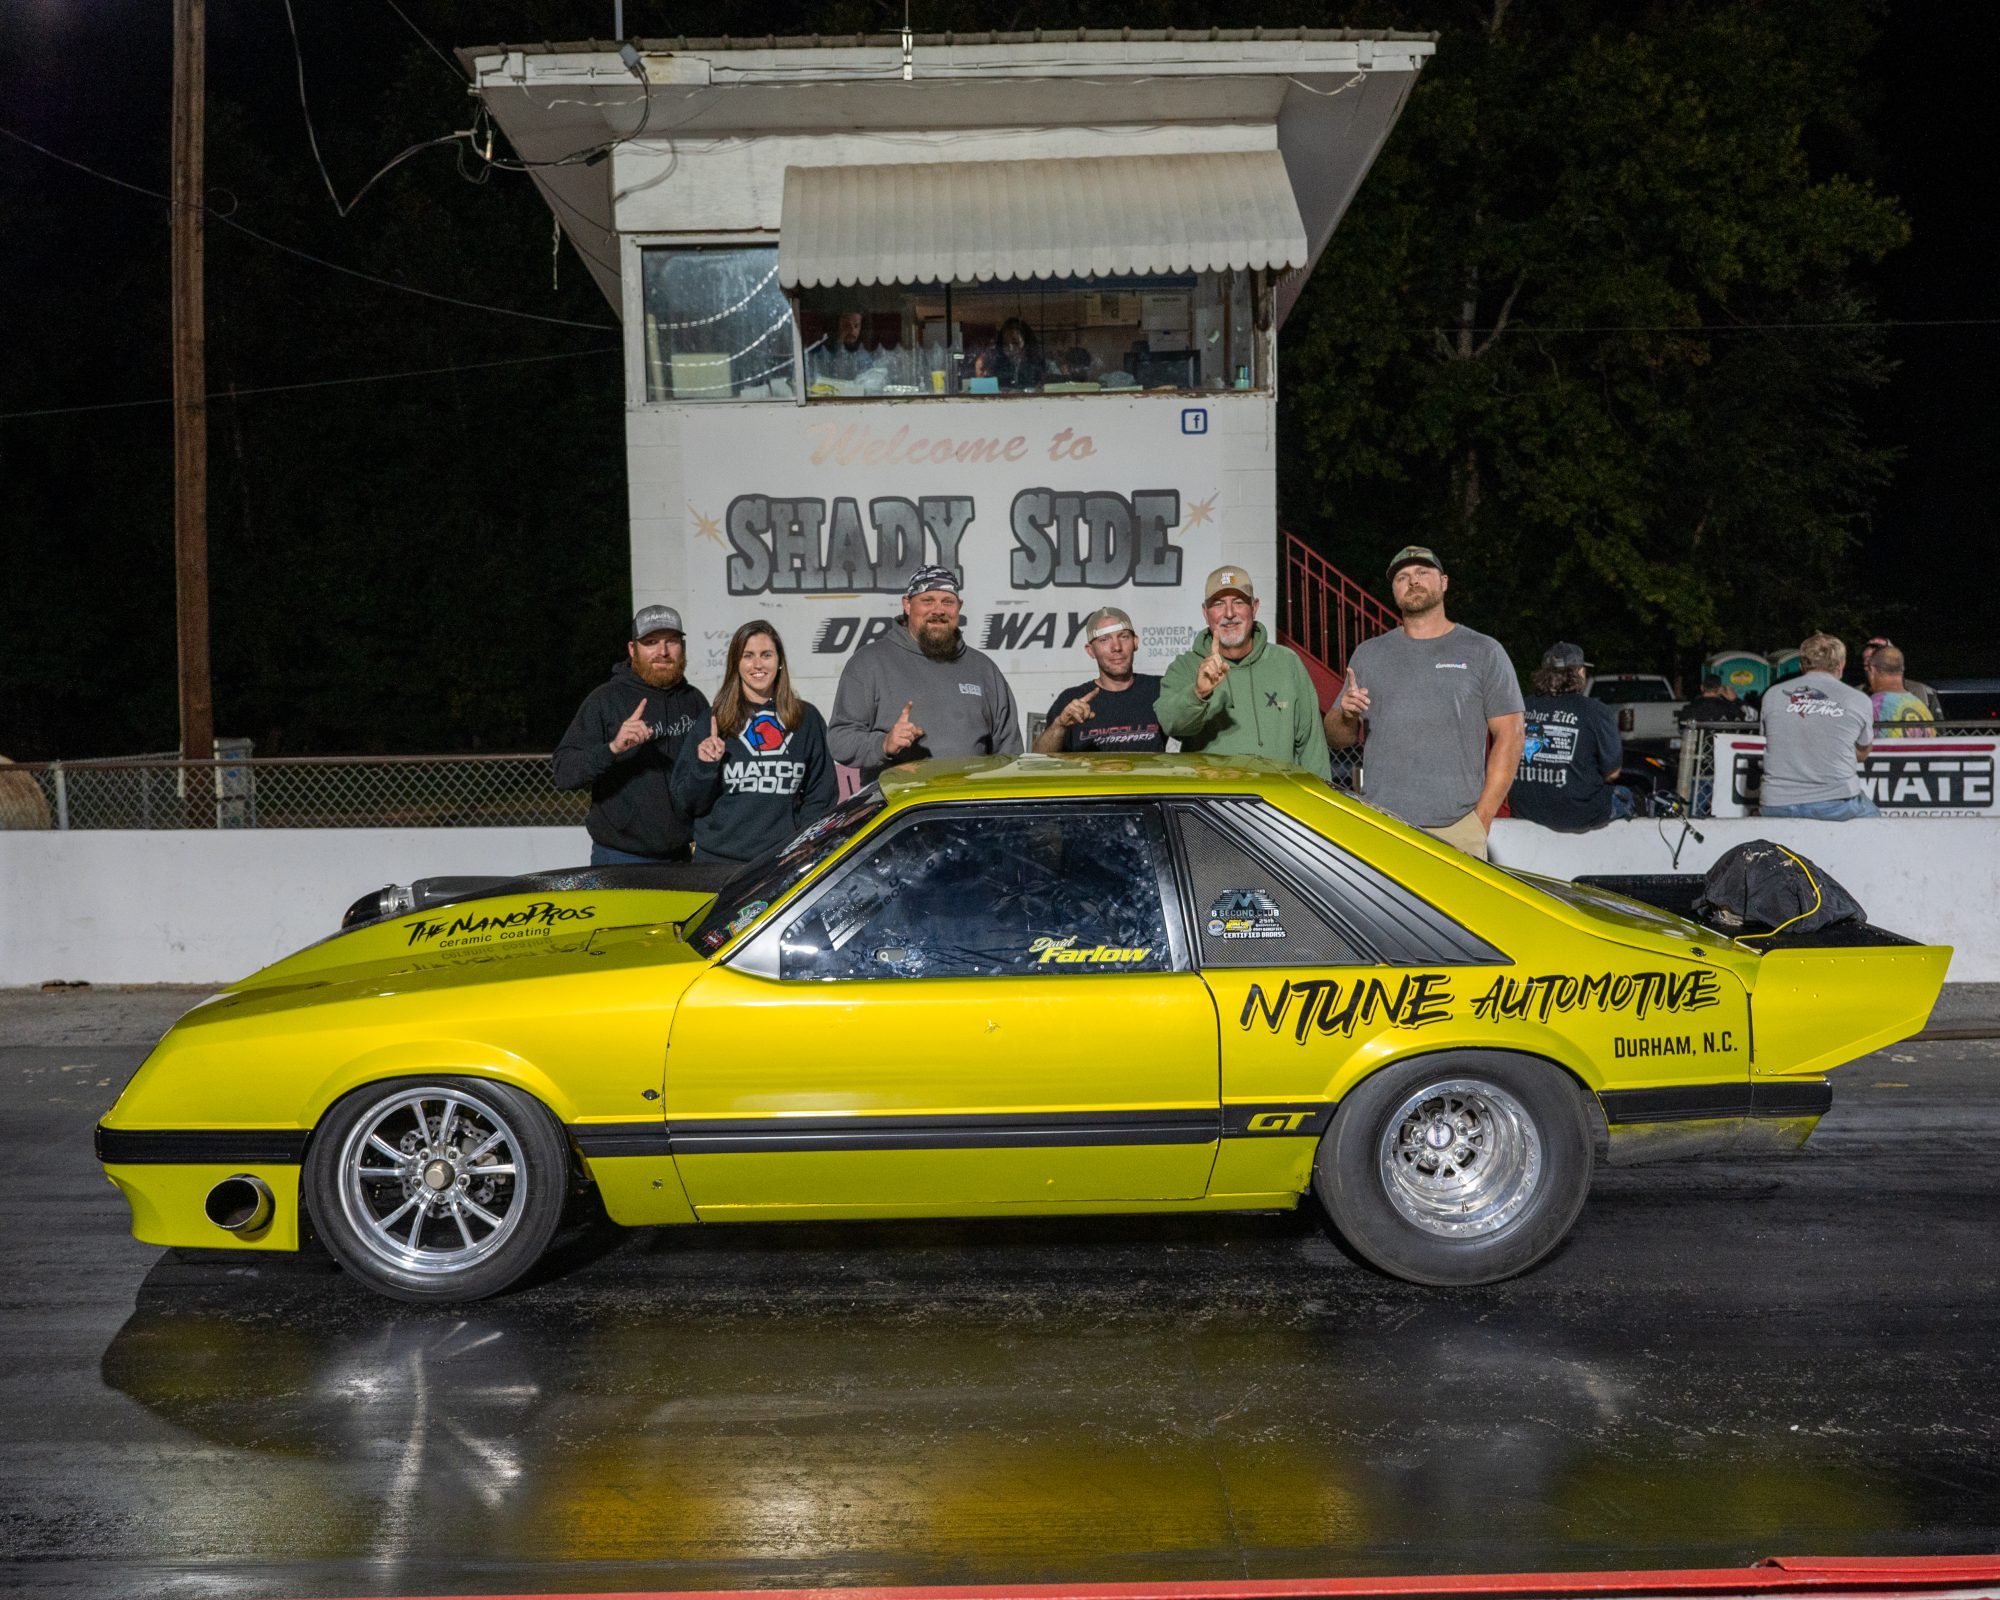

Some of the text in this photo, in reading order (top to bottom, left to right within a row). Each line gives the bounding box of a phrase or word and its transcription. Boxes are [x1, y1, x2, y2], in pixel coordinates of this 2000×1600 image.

[806, 421, 1097, 466] Welcome to
[726, 487, 1183, 596] SHADY SIDE
[1142, 626, 1186, 636] POWDER
[1142, 636, 1188, 646] COATING
[1552, 710, 1578, 725] Life
[1786, 703, 1844, 717] OUTLAWS
[723, 761, 806, 780] MATCO
[1514, 762, 1567, 788] iving
[725, 776, 801, 795] TOOLS
[1219, 909, 1255, 917] SECOND
[1257, 909, 1280, 917] CLUB
[439, 927, 551, 948] ceramic coating
[1028, 934, 1078, 953] David
[1037, 945, 1153, 963] Farlow
[1239, 970, 1721, 1045] NTUNE AUTOMOTIVE
[1614, 1031, 1738, 1059] DURHAM, N.C.
[1247, 1112, 1316, 1131] GT
